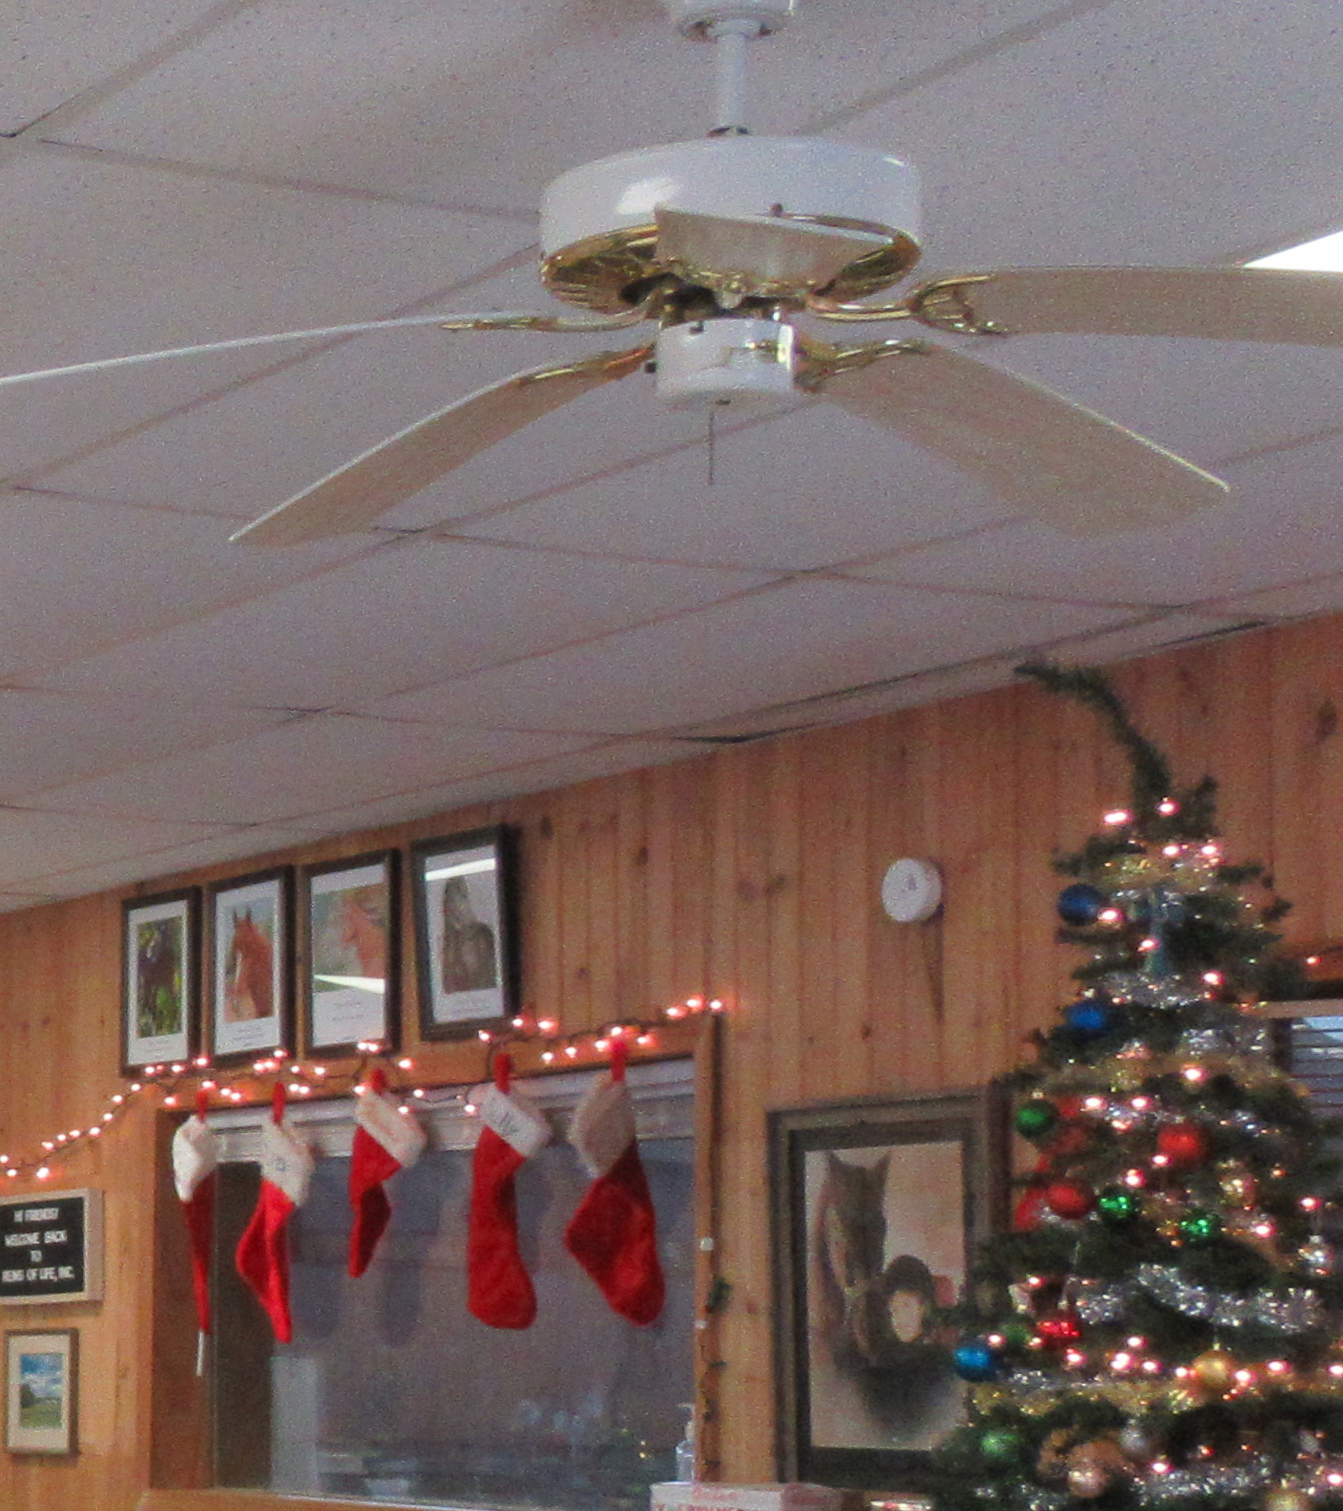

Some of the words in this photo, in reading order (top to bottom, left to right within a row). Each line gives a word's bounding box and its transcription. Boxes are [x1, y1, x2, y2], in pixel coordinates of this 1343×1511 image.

[44, 1230, 68, 1244] BACK
[30, 1250, 42, 1262] TO
[26, 1268, 38, 1281] OF
